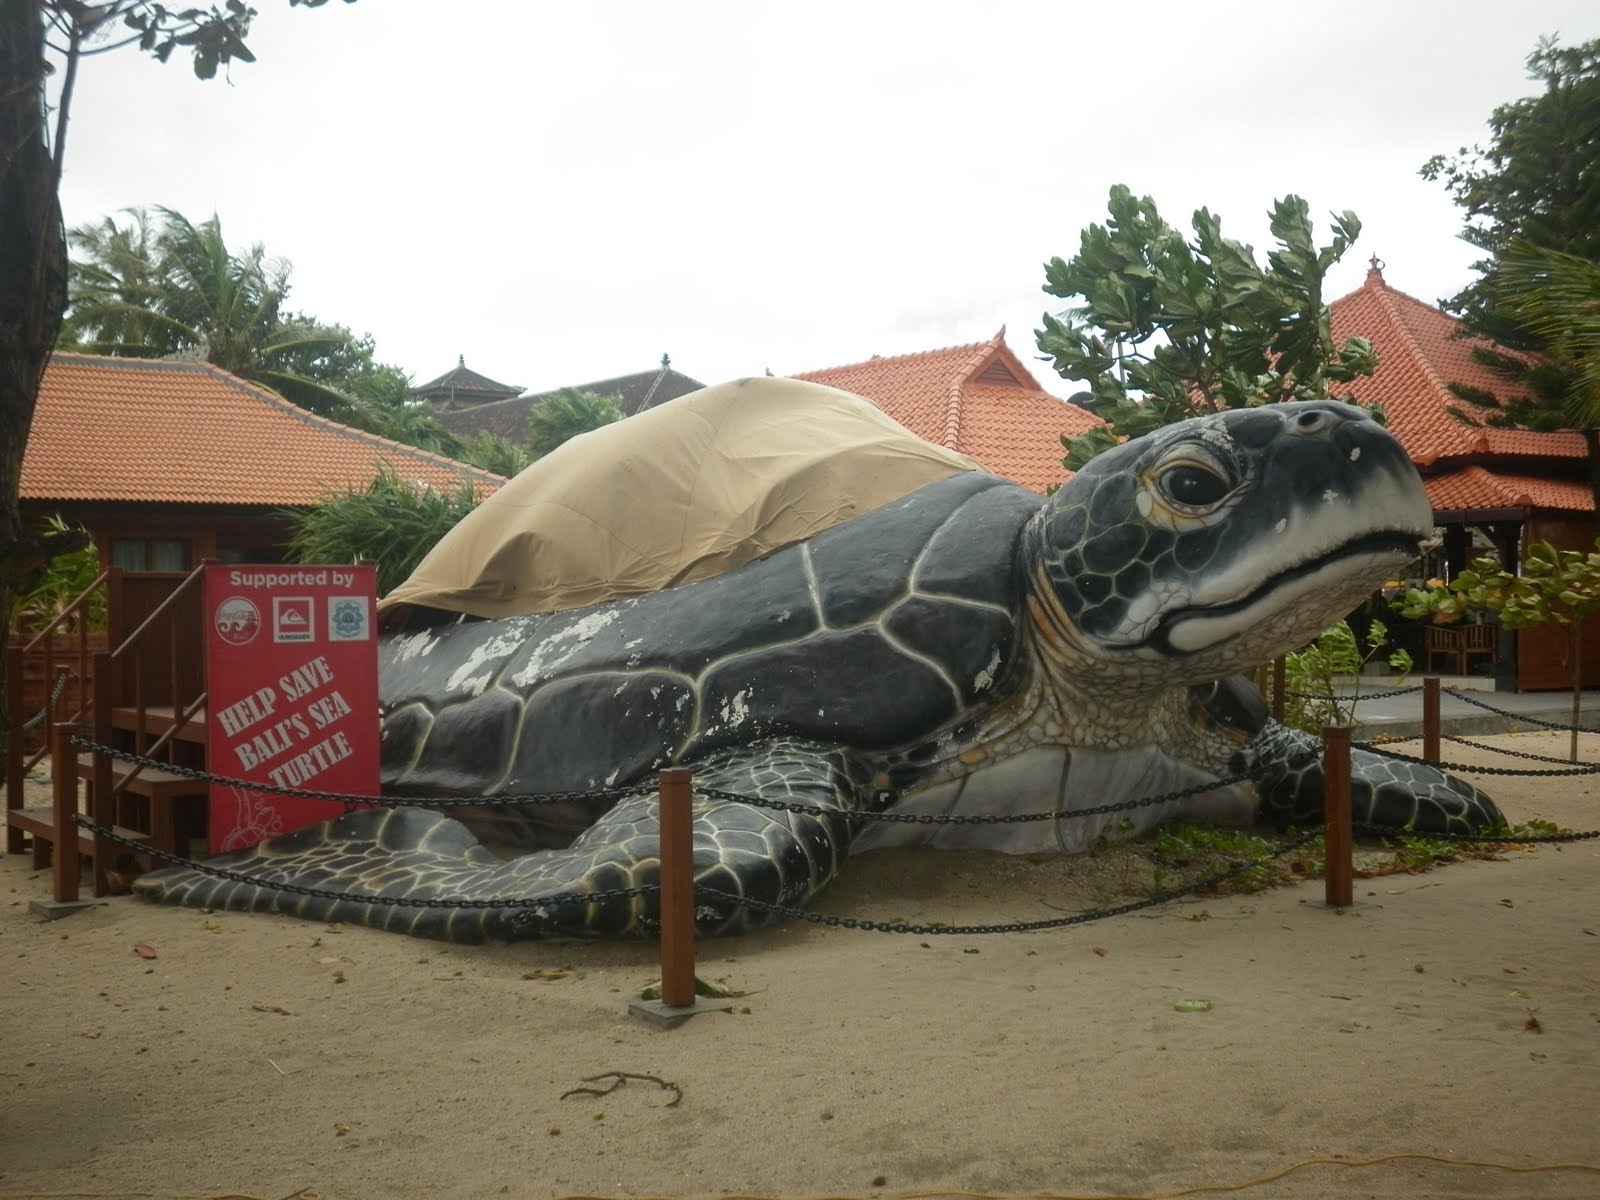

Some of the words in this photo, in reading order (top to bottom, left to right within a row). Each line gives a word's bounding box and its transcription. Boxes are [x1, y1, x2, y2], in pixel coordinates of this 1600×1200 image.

[230, 571, 327, 588] Supported
[332, 571, 354, 587] by
[216, 687, 276, 738] HELP
[278, 656, 334, 703] SAVE
[234, 713, 310, 772] BALI'S
[307, 690, 352, 730] SEA
[267, 731, 353, 790] TURTLE
